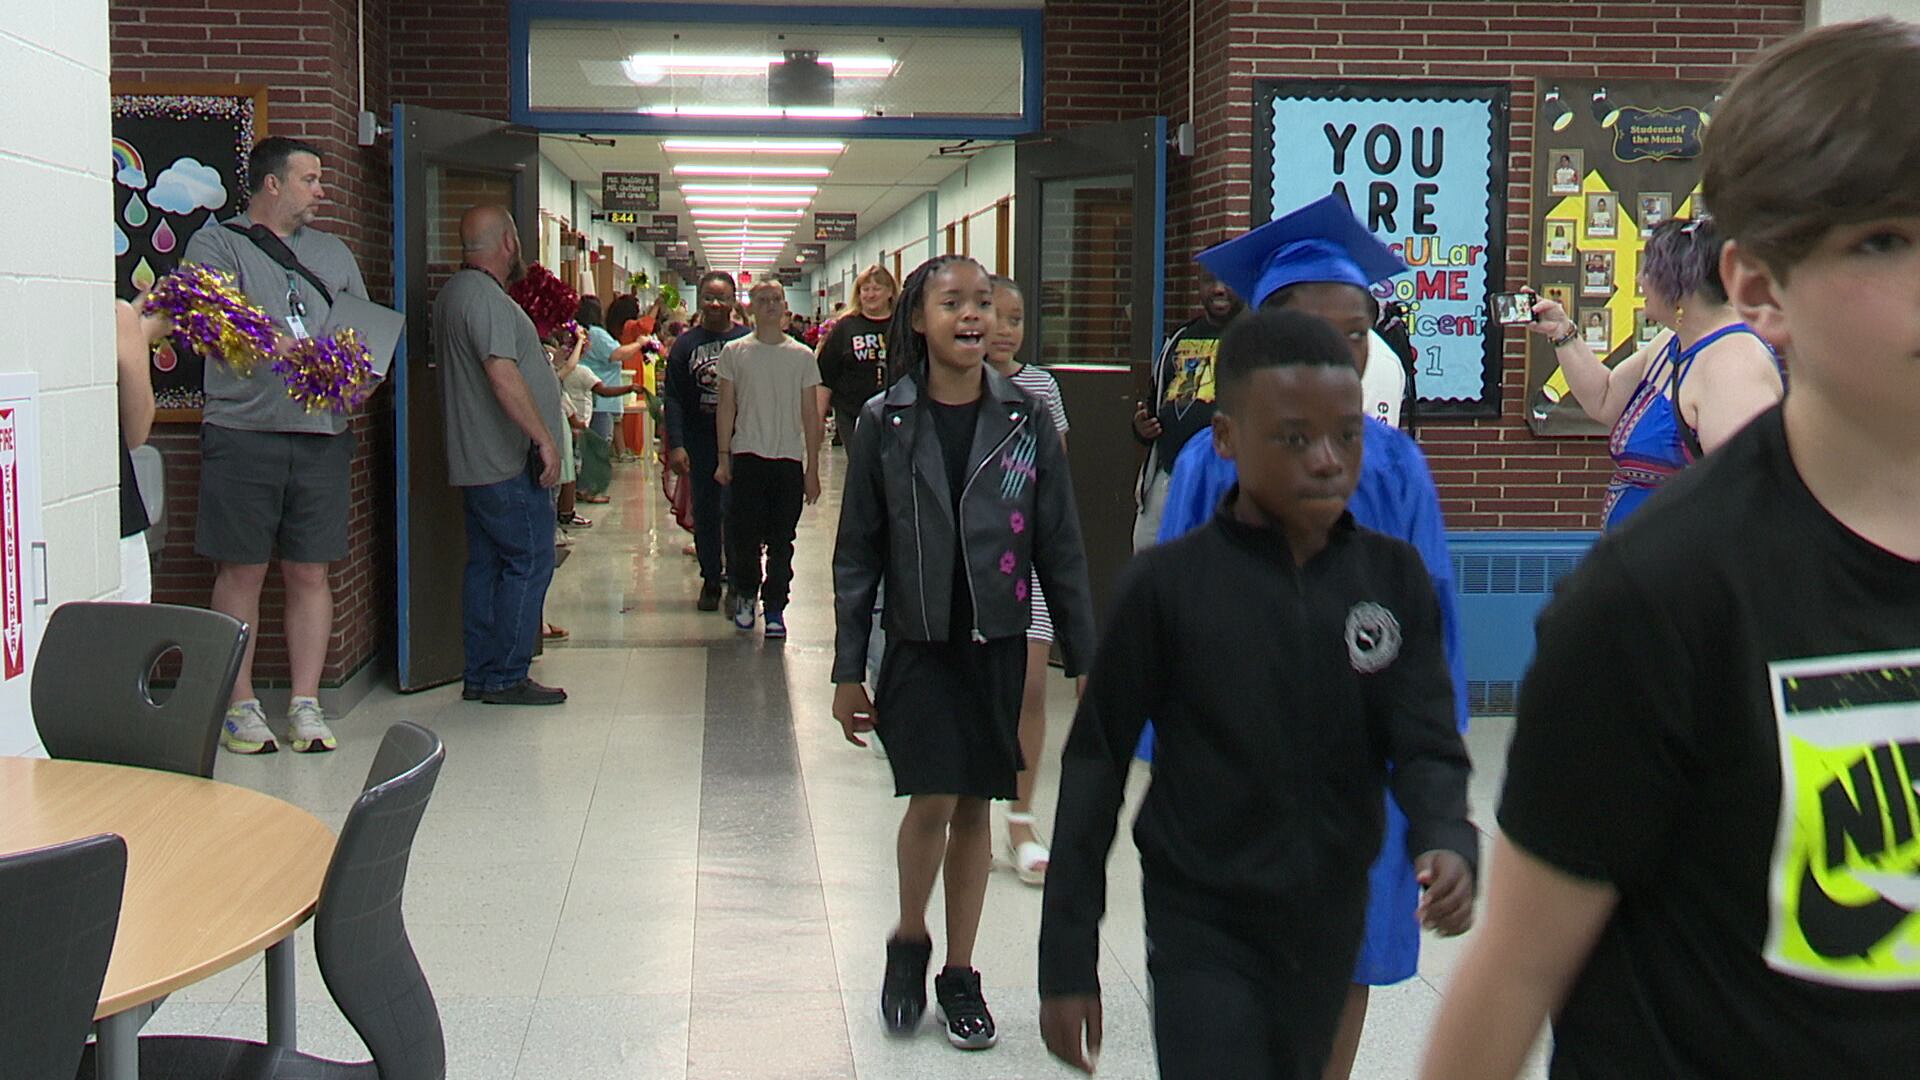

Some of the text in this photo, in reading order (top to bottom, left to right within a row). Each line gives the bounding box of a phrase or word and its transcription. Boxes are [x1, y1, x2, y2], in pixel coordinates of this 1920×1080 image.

[1630, 125, 1686, 134] Students of
[1632, 135, 1683, 144] the Month
[1324, 123, 1444, 178] YOU
[611, 212, 634, 223] 8:44
[4, 464, 17, 652] EXTINGUISHER
